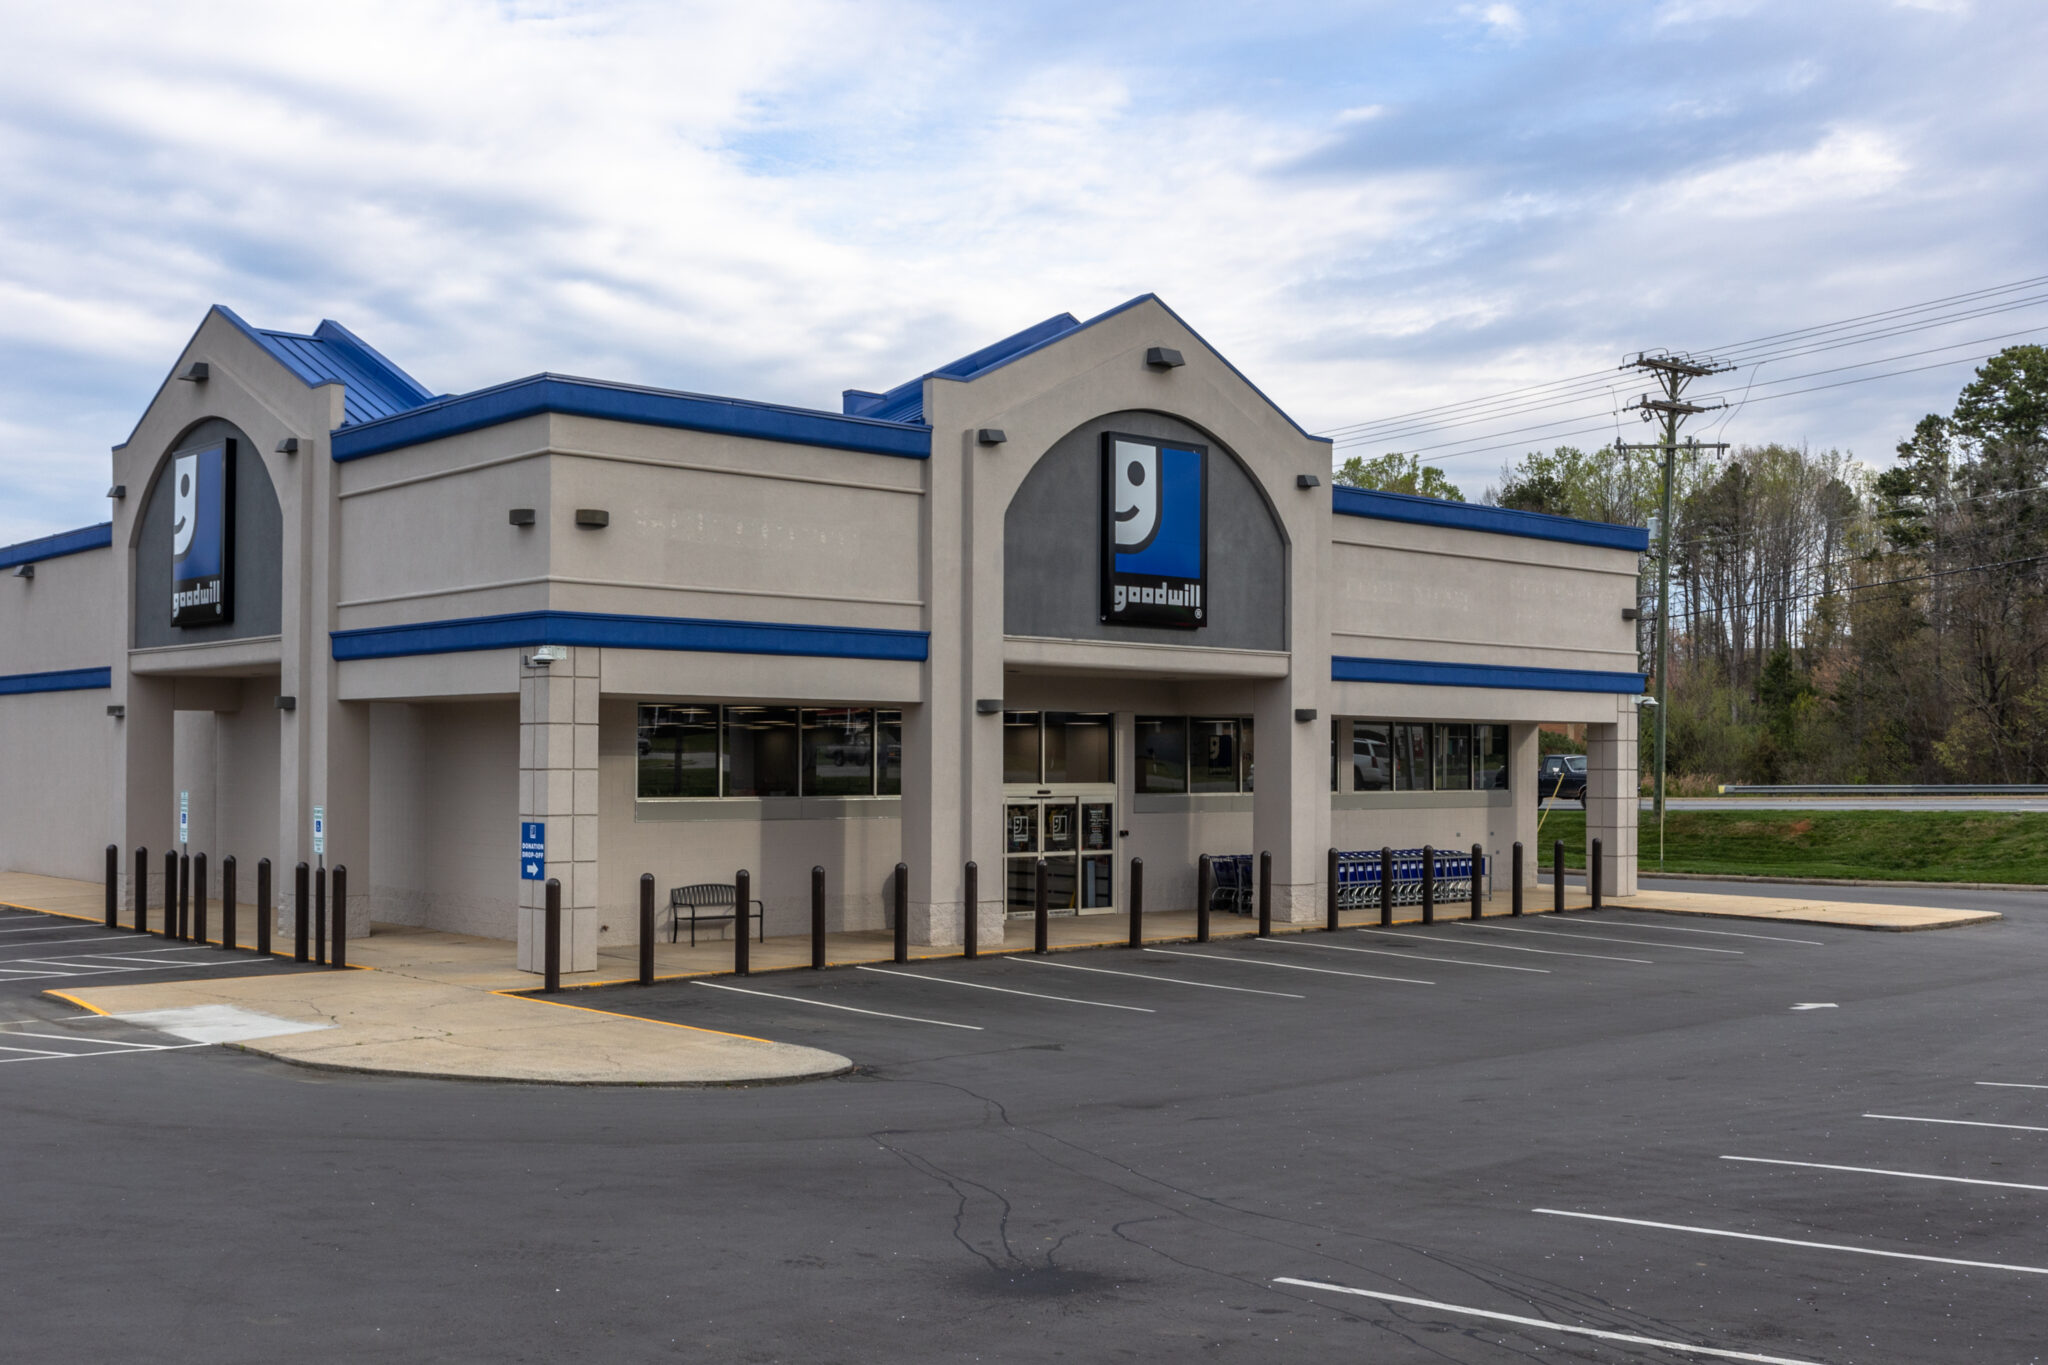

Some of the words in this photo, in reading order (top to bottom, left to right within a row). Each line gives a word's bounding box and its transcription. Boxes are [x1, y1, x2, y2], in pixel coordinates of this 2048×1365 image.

[173, 580, 220, 618] goodwill
[1114, 581, 1200, 612] goodwill
[522, 842, 544, 850] DONATION
[522, 851, 544, 859] DROP-OFF
